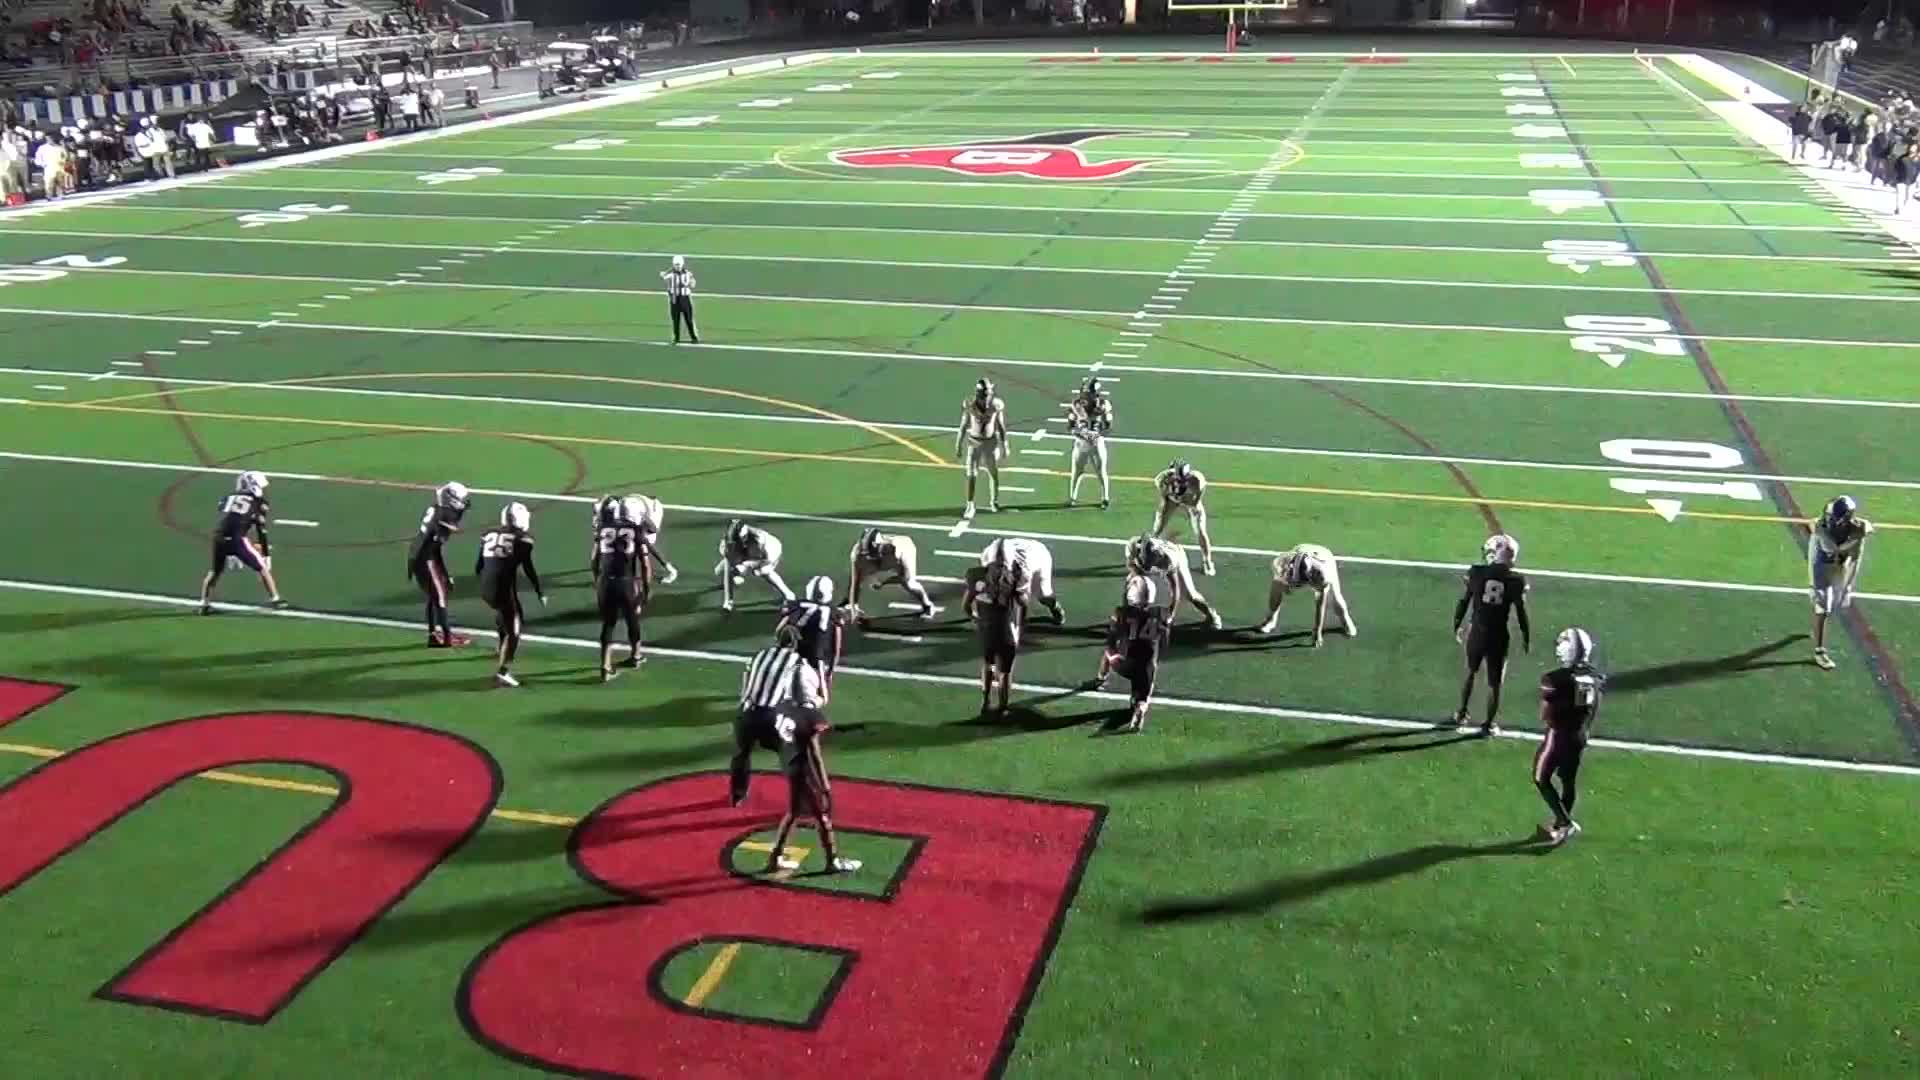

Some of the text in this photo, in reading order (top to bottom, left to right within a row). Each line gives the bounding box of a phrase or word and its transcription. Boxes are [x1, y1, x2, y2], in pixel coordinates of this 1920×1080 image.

[1564, 314, 1686, 356] 20
[1600, 438, 1764, 501] 10
[224, 494, 254, 515] 15
[482, 532, 516, 558] 25
[599, 526, 636, 554] 23
[1482, 579, 1506, 605] 8
[796, 601, 831, 632] 71
[0, 677, 1107, 1080] BU
